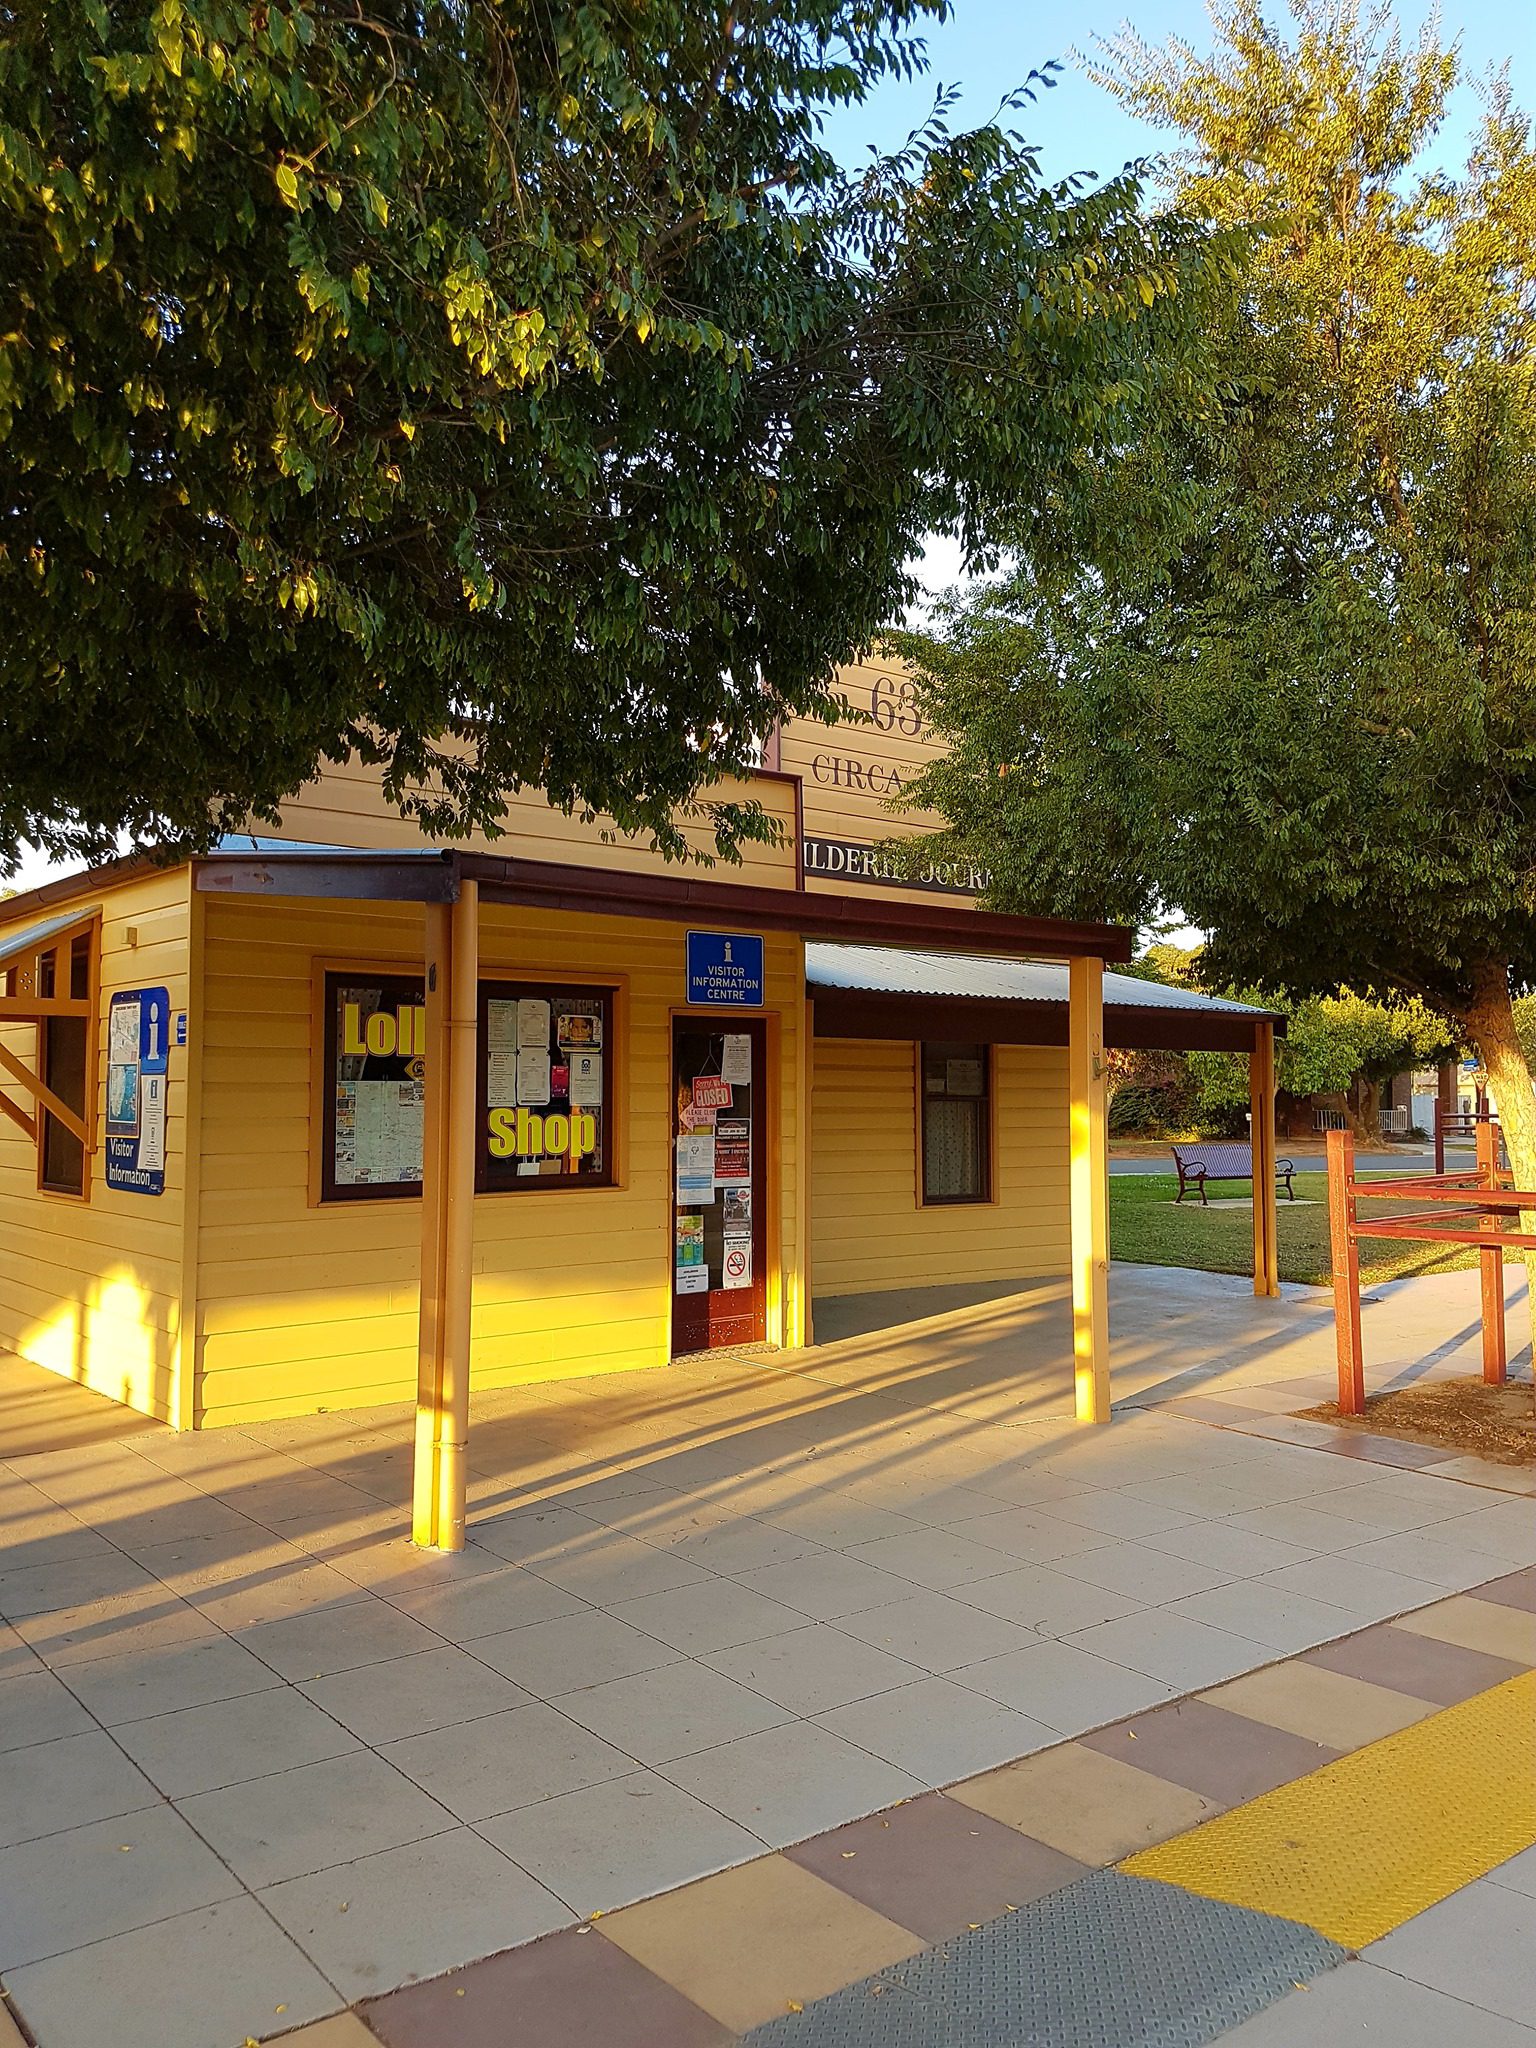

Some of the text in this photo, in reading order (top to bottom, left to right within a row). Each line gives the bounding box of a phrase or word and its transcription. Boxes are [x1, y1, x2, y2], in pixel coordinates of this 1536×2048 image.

[872, 677, 922, 736] 63
[811, 753, 903, 795] CIRCA
[707, 965, 745, 977] VISITOR
[692, 976, 759, 989] INFORMATION
[707, 988, 745, 1000] CENTRE
[696, 1087, 729, 1107] CLOSED
[488, 1107, 596, 1158] Shop
[110, 1137, 135, 1158] Visitor
[109, 1162, 151, 1187] Information
